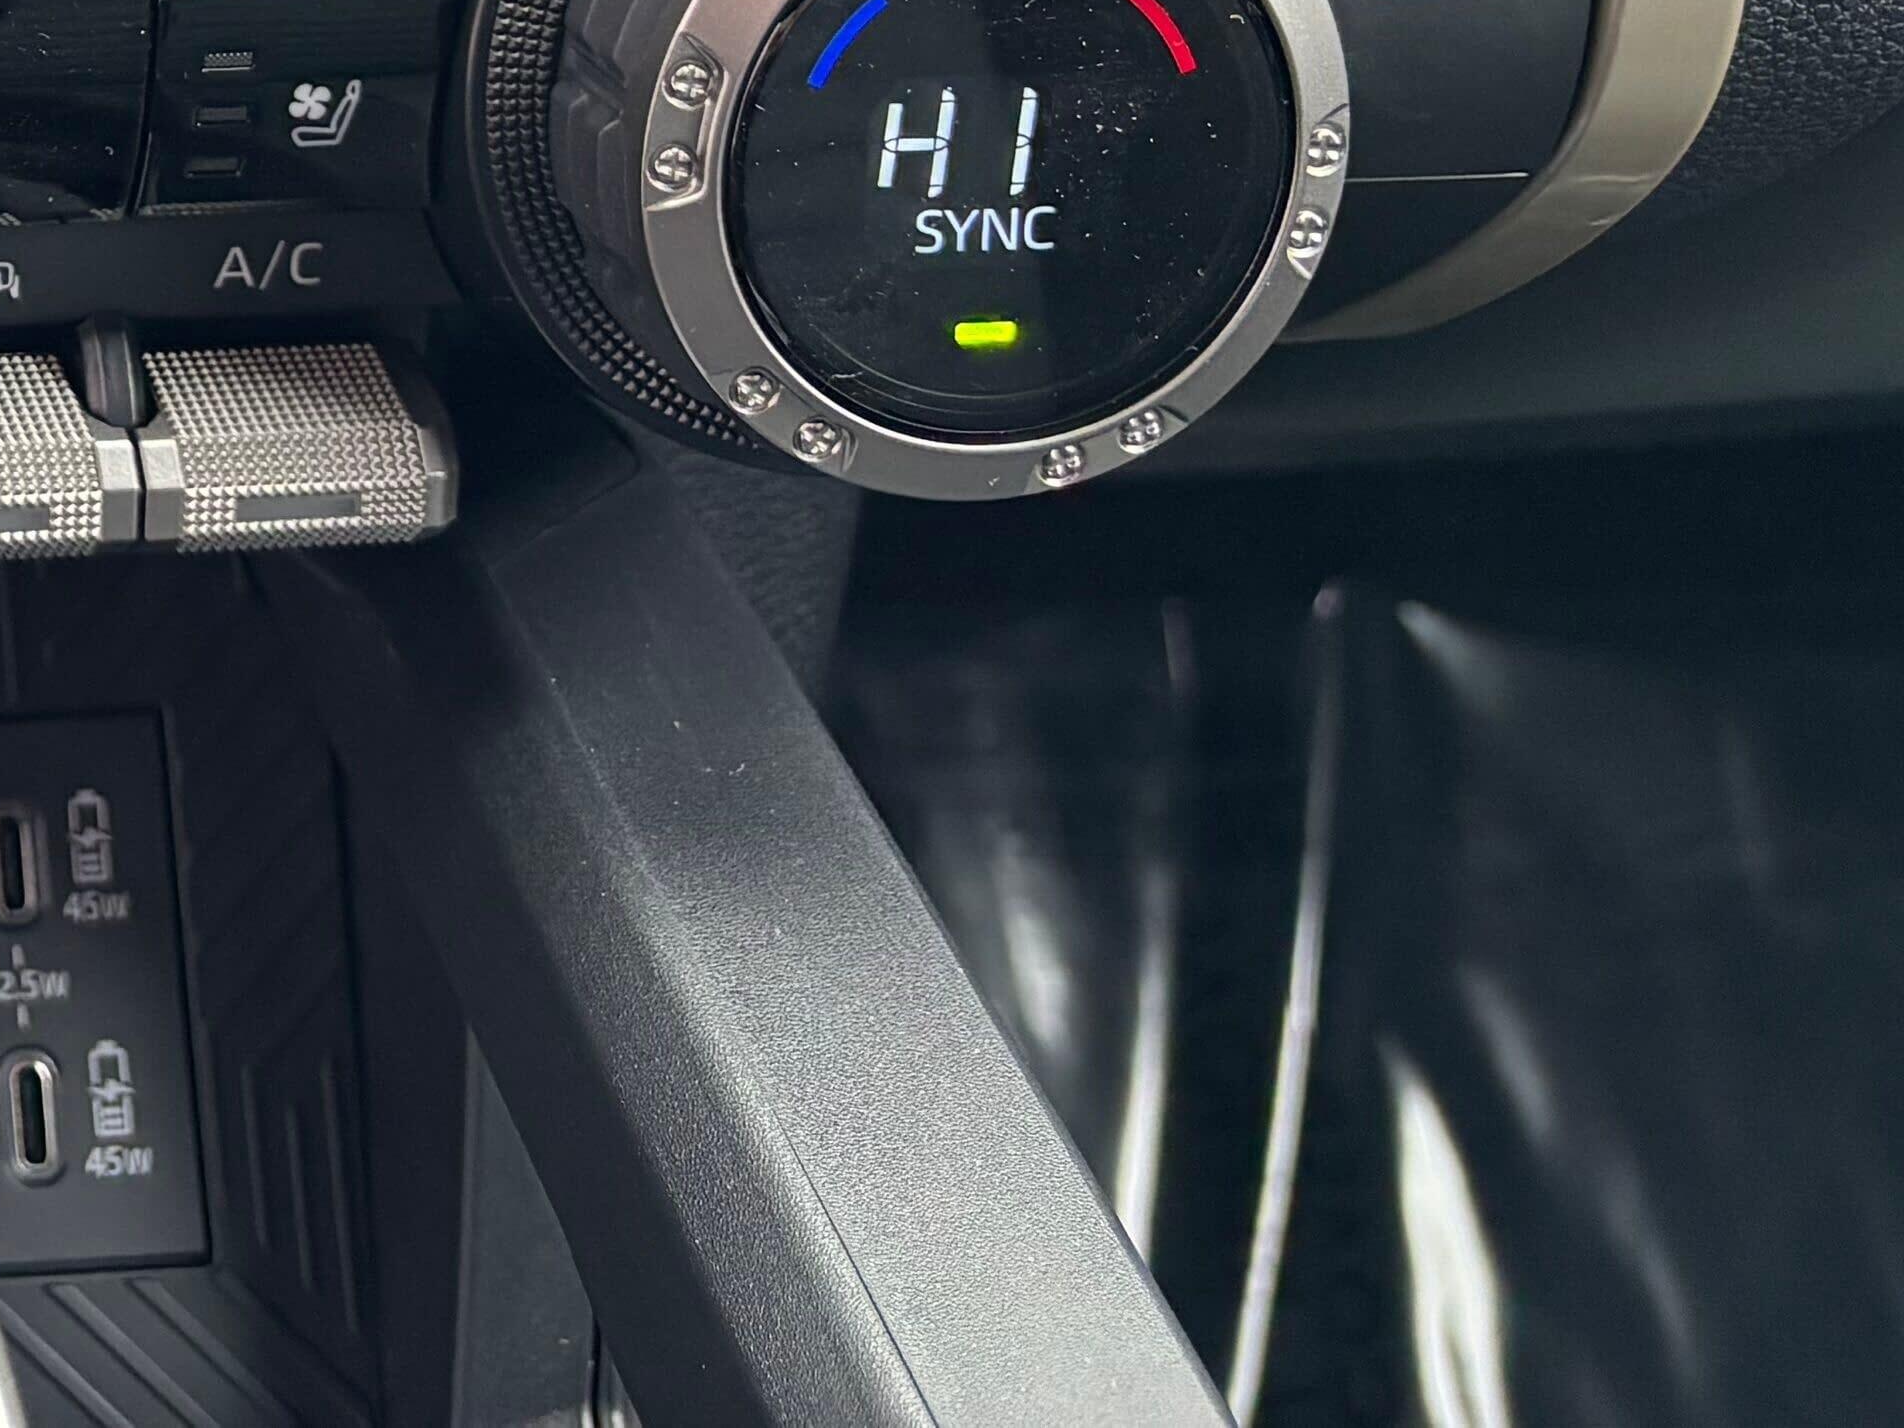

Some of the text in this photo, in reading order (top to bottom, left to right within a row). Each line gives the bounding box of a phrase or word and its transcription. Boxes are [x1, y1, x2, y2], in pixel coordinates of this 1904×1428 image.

[914, 205, 1058, 255] SYNC
[214, 239, 324, 291] A/C
[63, 890, 130, 922] 45W
[85, 1145, 154, 1177] 45W
